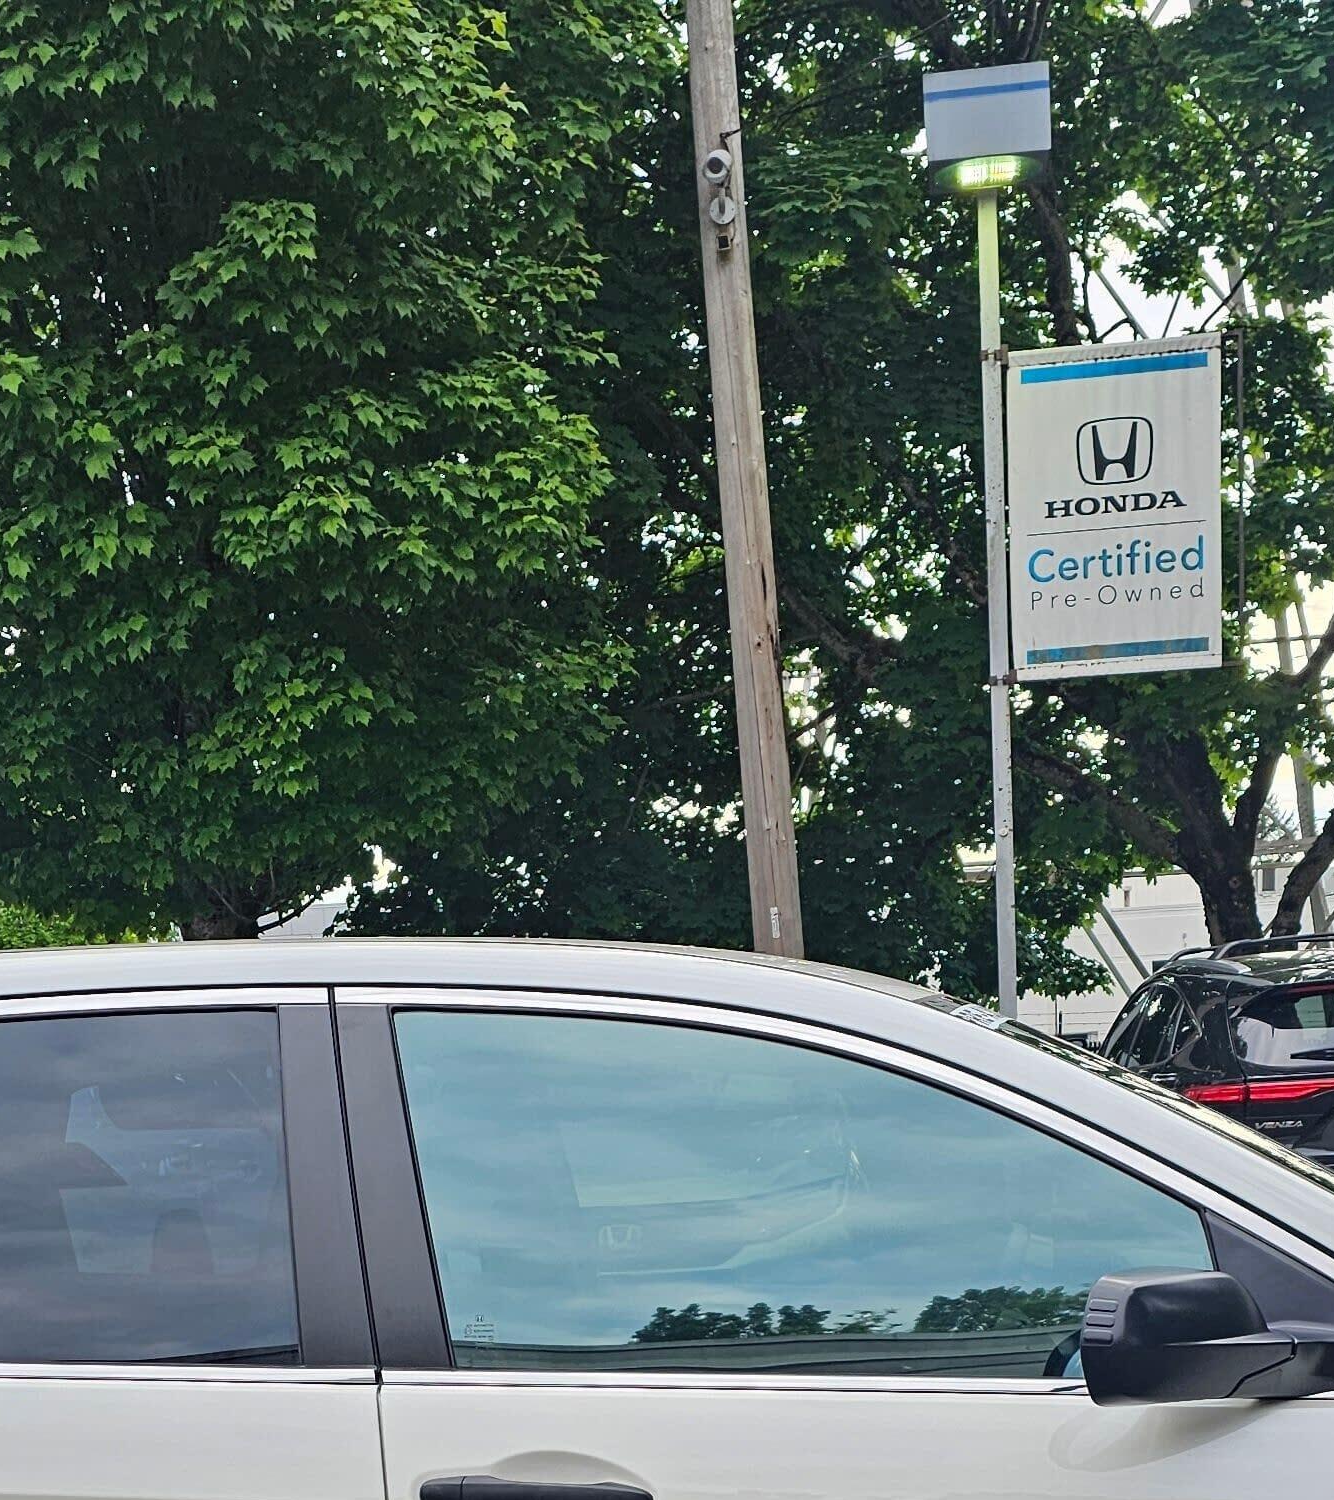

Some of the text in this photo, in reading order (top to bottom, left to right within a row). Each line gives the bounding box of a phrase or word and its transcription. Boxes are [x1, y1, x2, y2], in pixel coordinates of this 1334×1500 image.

[1044, 490, 1187, 518] HONDA
[1028, 534, 1204, 583] Certified
[1031, 577, 1204, 610] Pre-Owned
